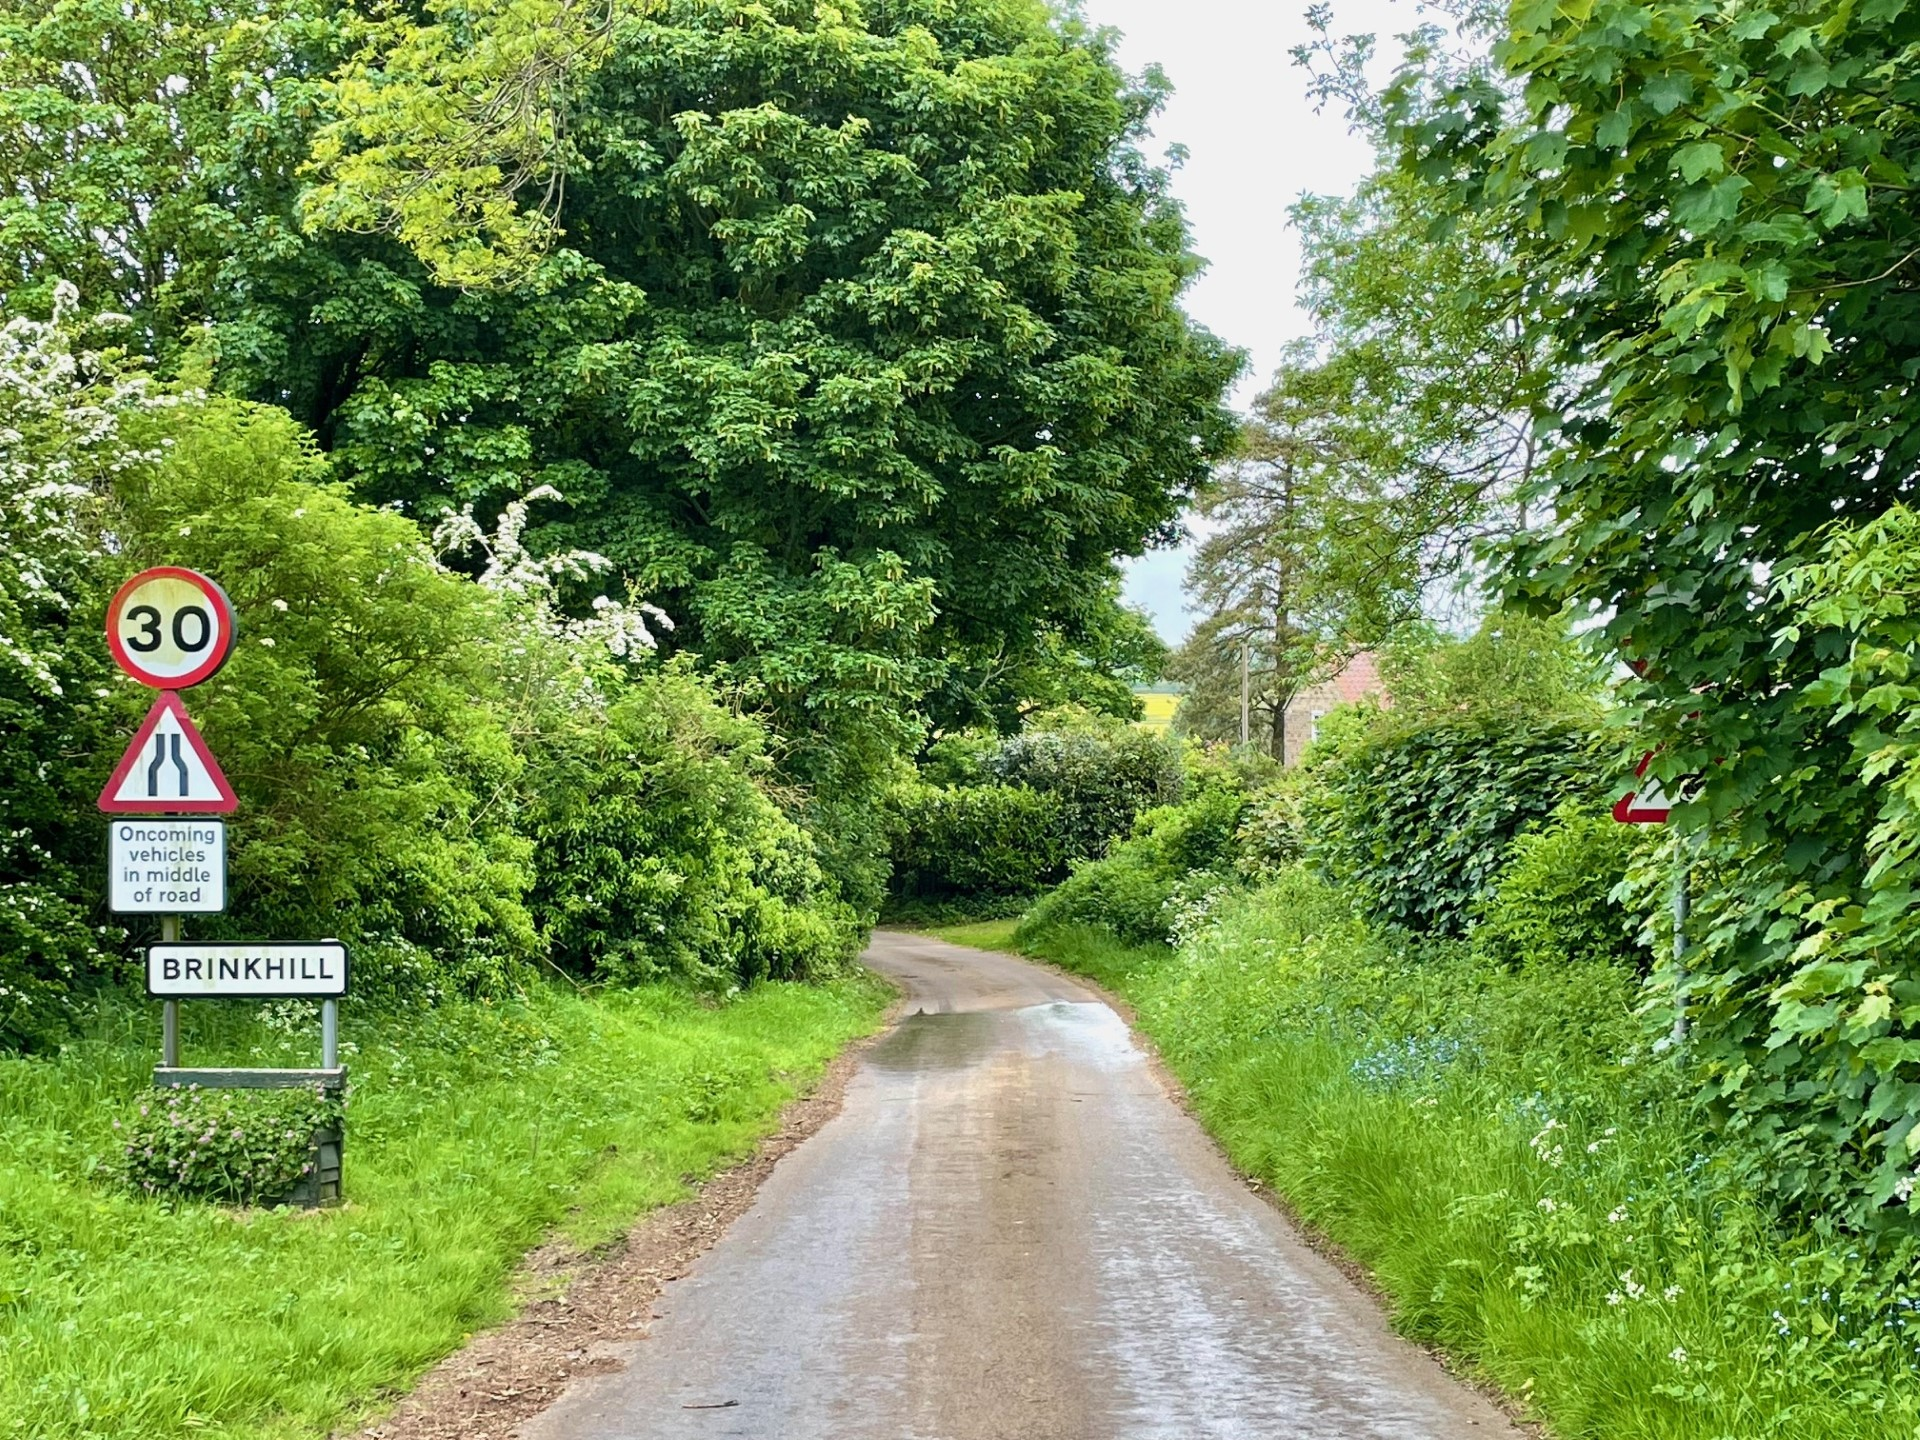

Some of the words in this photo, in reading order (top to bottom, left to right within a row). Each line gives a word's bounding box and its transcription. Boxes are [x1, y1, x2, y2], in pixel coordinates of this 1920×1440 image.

[126, 604, 211, 653] 30
[120, 826, 215, 845] Oncoming
[129, 847, 206, 862] vehicles
[123, 867, 140, 882] in
[146, 867, 210, 882] middle
[133, 887, 152, 902] of
[159, 887, 201, 902] road
[163, 957, 334, 980] BRINKHILL
